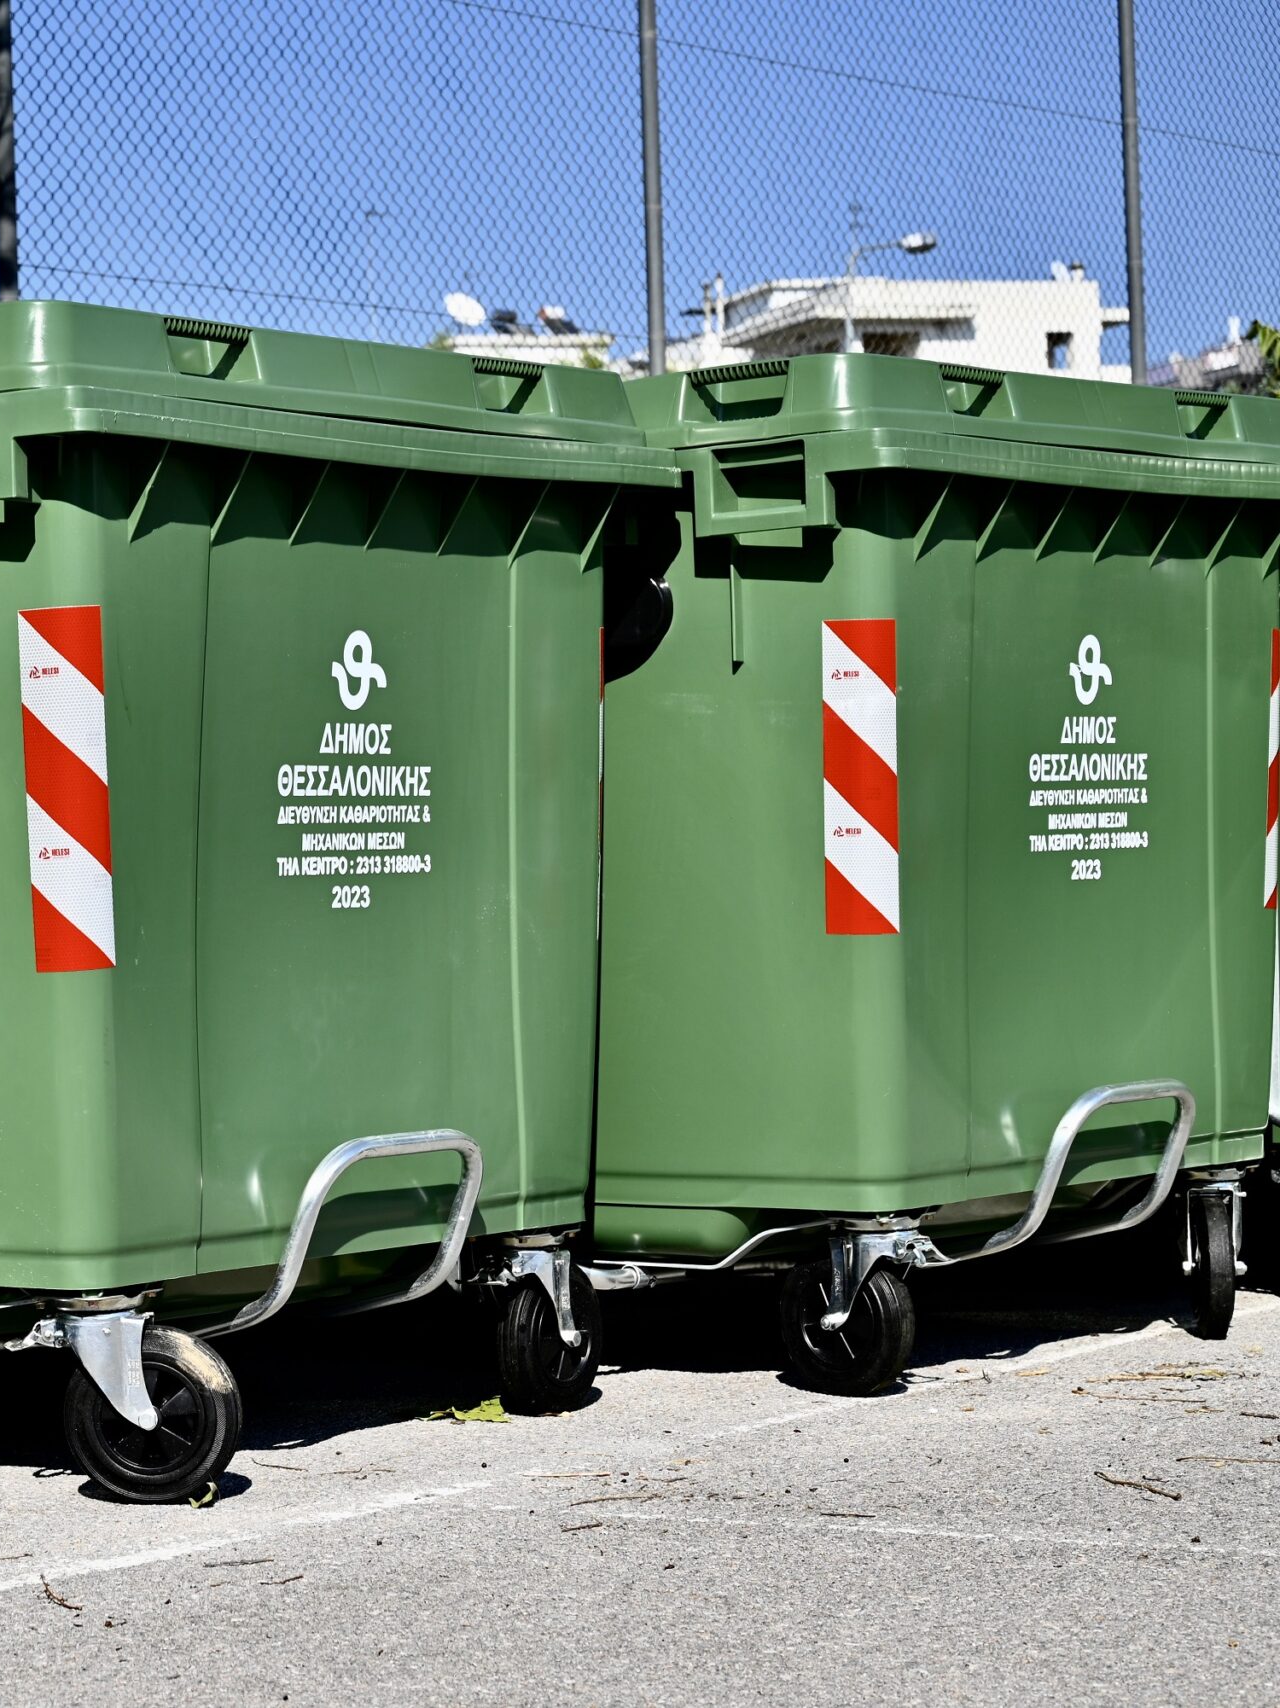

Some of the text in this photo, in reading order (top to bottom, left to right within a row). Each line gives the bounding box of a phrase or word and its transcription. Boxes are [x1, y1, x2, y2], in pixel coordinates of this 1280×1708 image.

[320, 723, 392, 754] ΔΗΜΟΣ
[1061, 716, 1116, 744] ΔΗΜΟΣ
[1029, 754, 1147, 782] ΘΕΣΣΑΛΟΝΙΚΗΣ
[278, 764, 431, 796] ΘΕΣΣΑΛΟΝΙΚΗΣ
[1030, 790, 1075, 806] ΔΙΕΥΘΥΝΣΗ
[1077, 788, 1139, 804] ΚΑΘΑΡΙΟΤΗΤΑΣ
[277, 805, 430, 824] ΔΙΕΥΘΥΝΣΗ ΚΑΘΑΡΙΟΤΗΤΑΣ &
[1049, 812, 1127, 829] ΜΗΧΑΝΙΚΩΝ ΜΕΣΩΝ
[302, 832, 405, 851] ΜΗΧΑΝΙΚΩΝ ΜΕΣΩΝ
[1029, 835, 1047, 851] ΤΗΛ
[1048, 834, 1084, 851] ΚΕΝΤΡΟ
[1090, 833, 1109, 849] 2313
[277, 855, 431, 876] ΤΗΛ ΚΕΝΤΡΟ : 2313 318800-3
[1071, 859, 1101, 880] 2023
[332, 885, 370, 908] 2023
